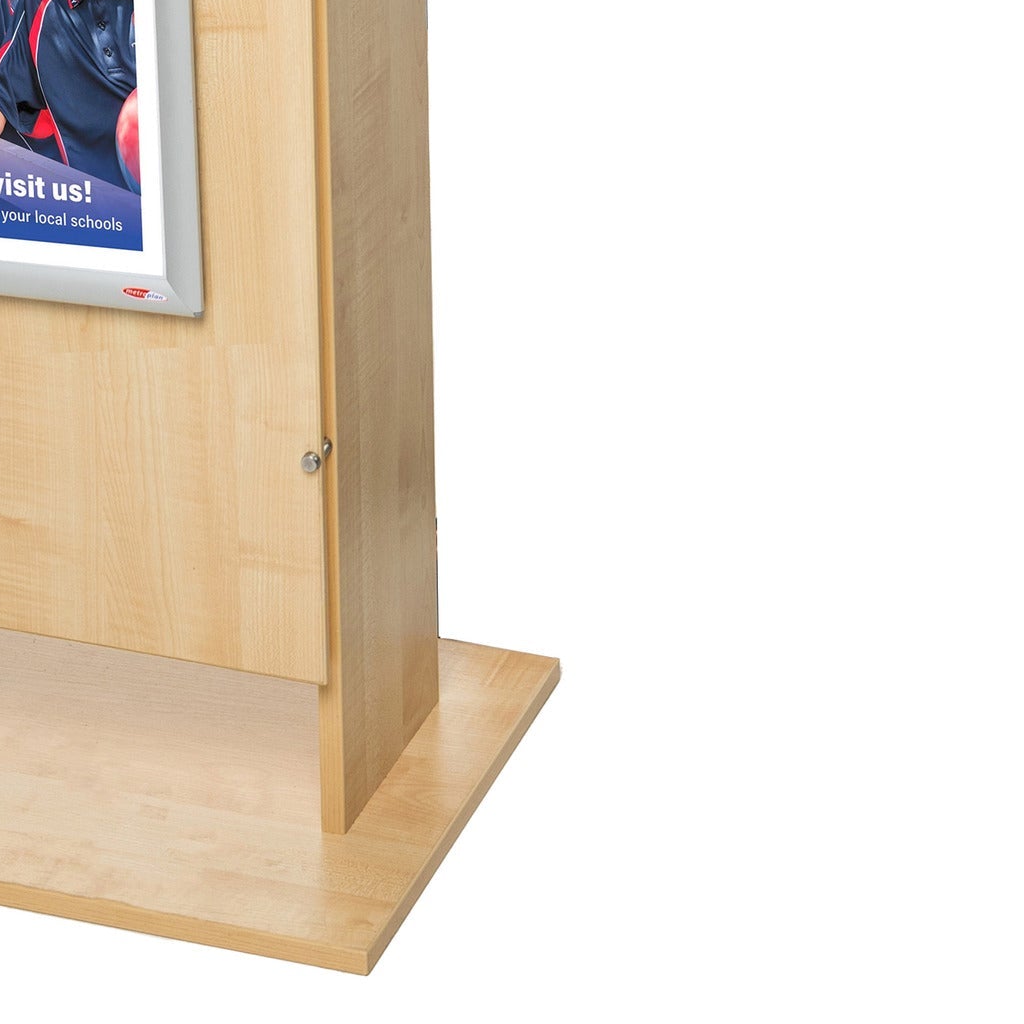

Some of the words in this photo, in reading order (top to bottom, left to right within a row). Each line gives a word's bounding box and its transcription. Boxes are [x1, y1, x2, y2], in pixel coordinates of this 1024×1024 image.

[52, 180, 91, 203] us!
[1, 209, 31, 224] your
[35, 210, 66, 226] local
[70, 215, 123, 231] schools
